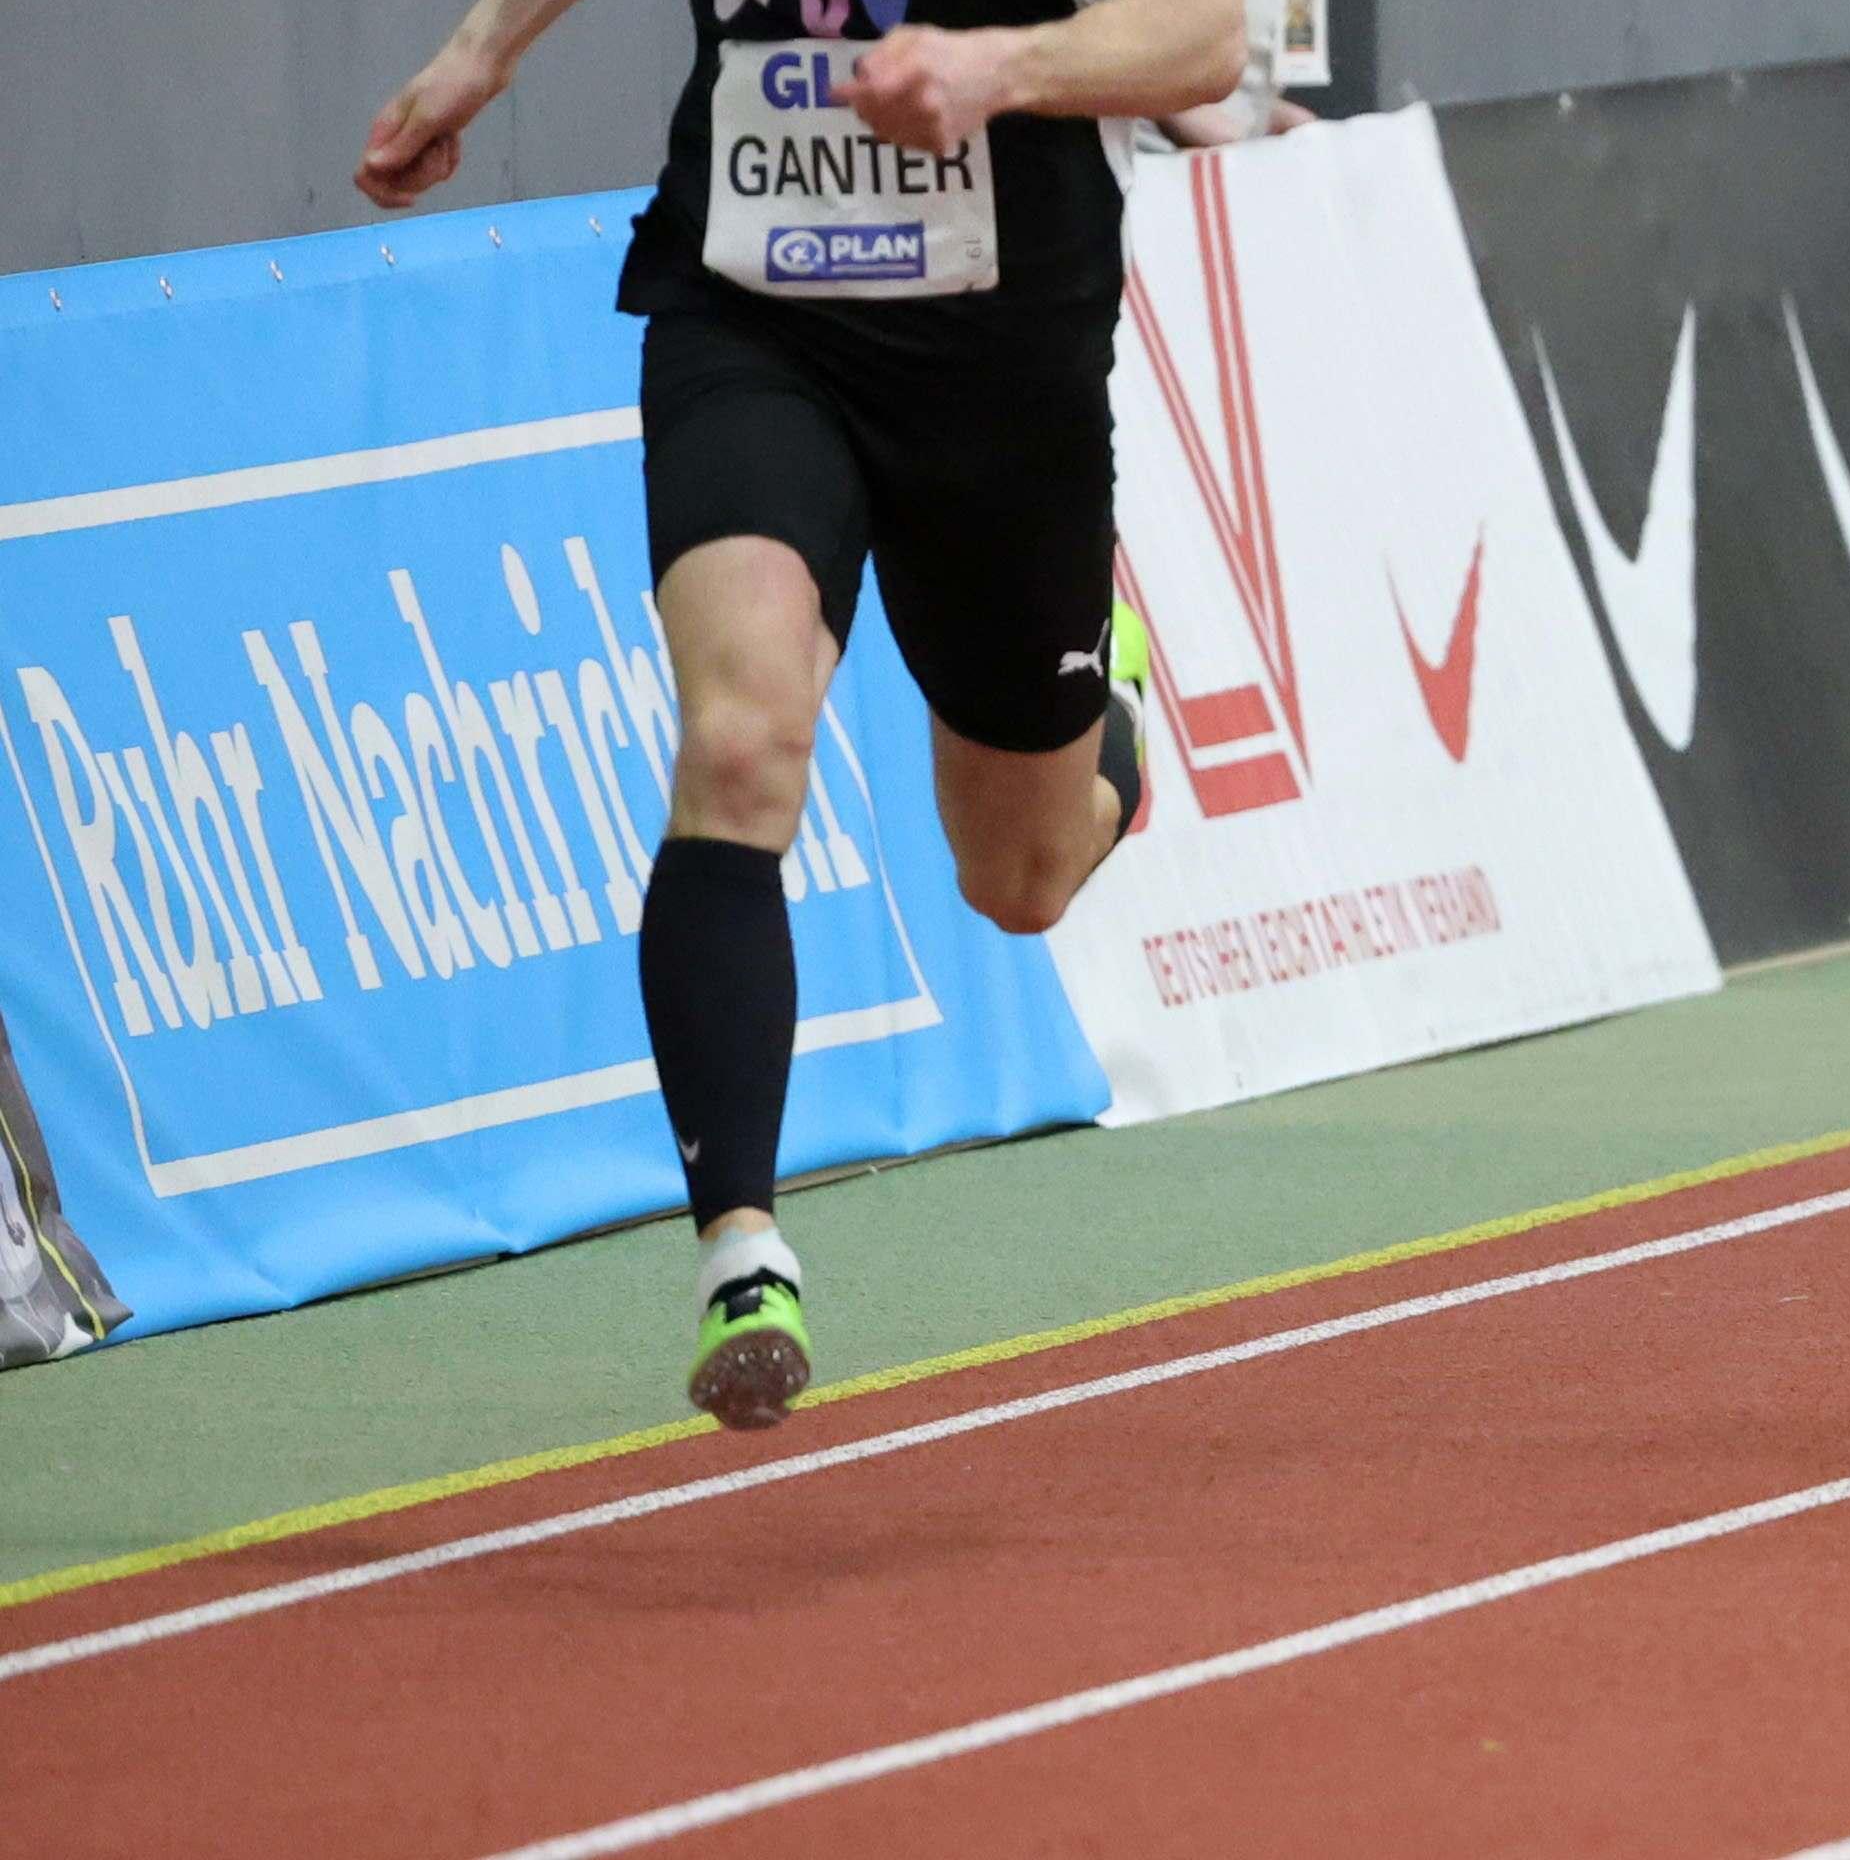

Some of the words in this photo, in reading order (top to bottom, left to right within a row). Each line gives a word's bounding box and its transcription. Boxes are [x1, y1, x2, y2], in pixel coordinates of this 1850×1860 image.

[761, 51, 854, 110] GL
[729, 135, 974, 196] GANTER
[829, 234, 919, 261] PLAN
[16, 615, 324, 1036] Ruhr
